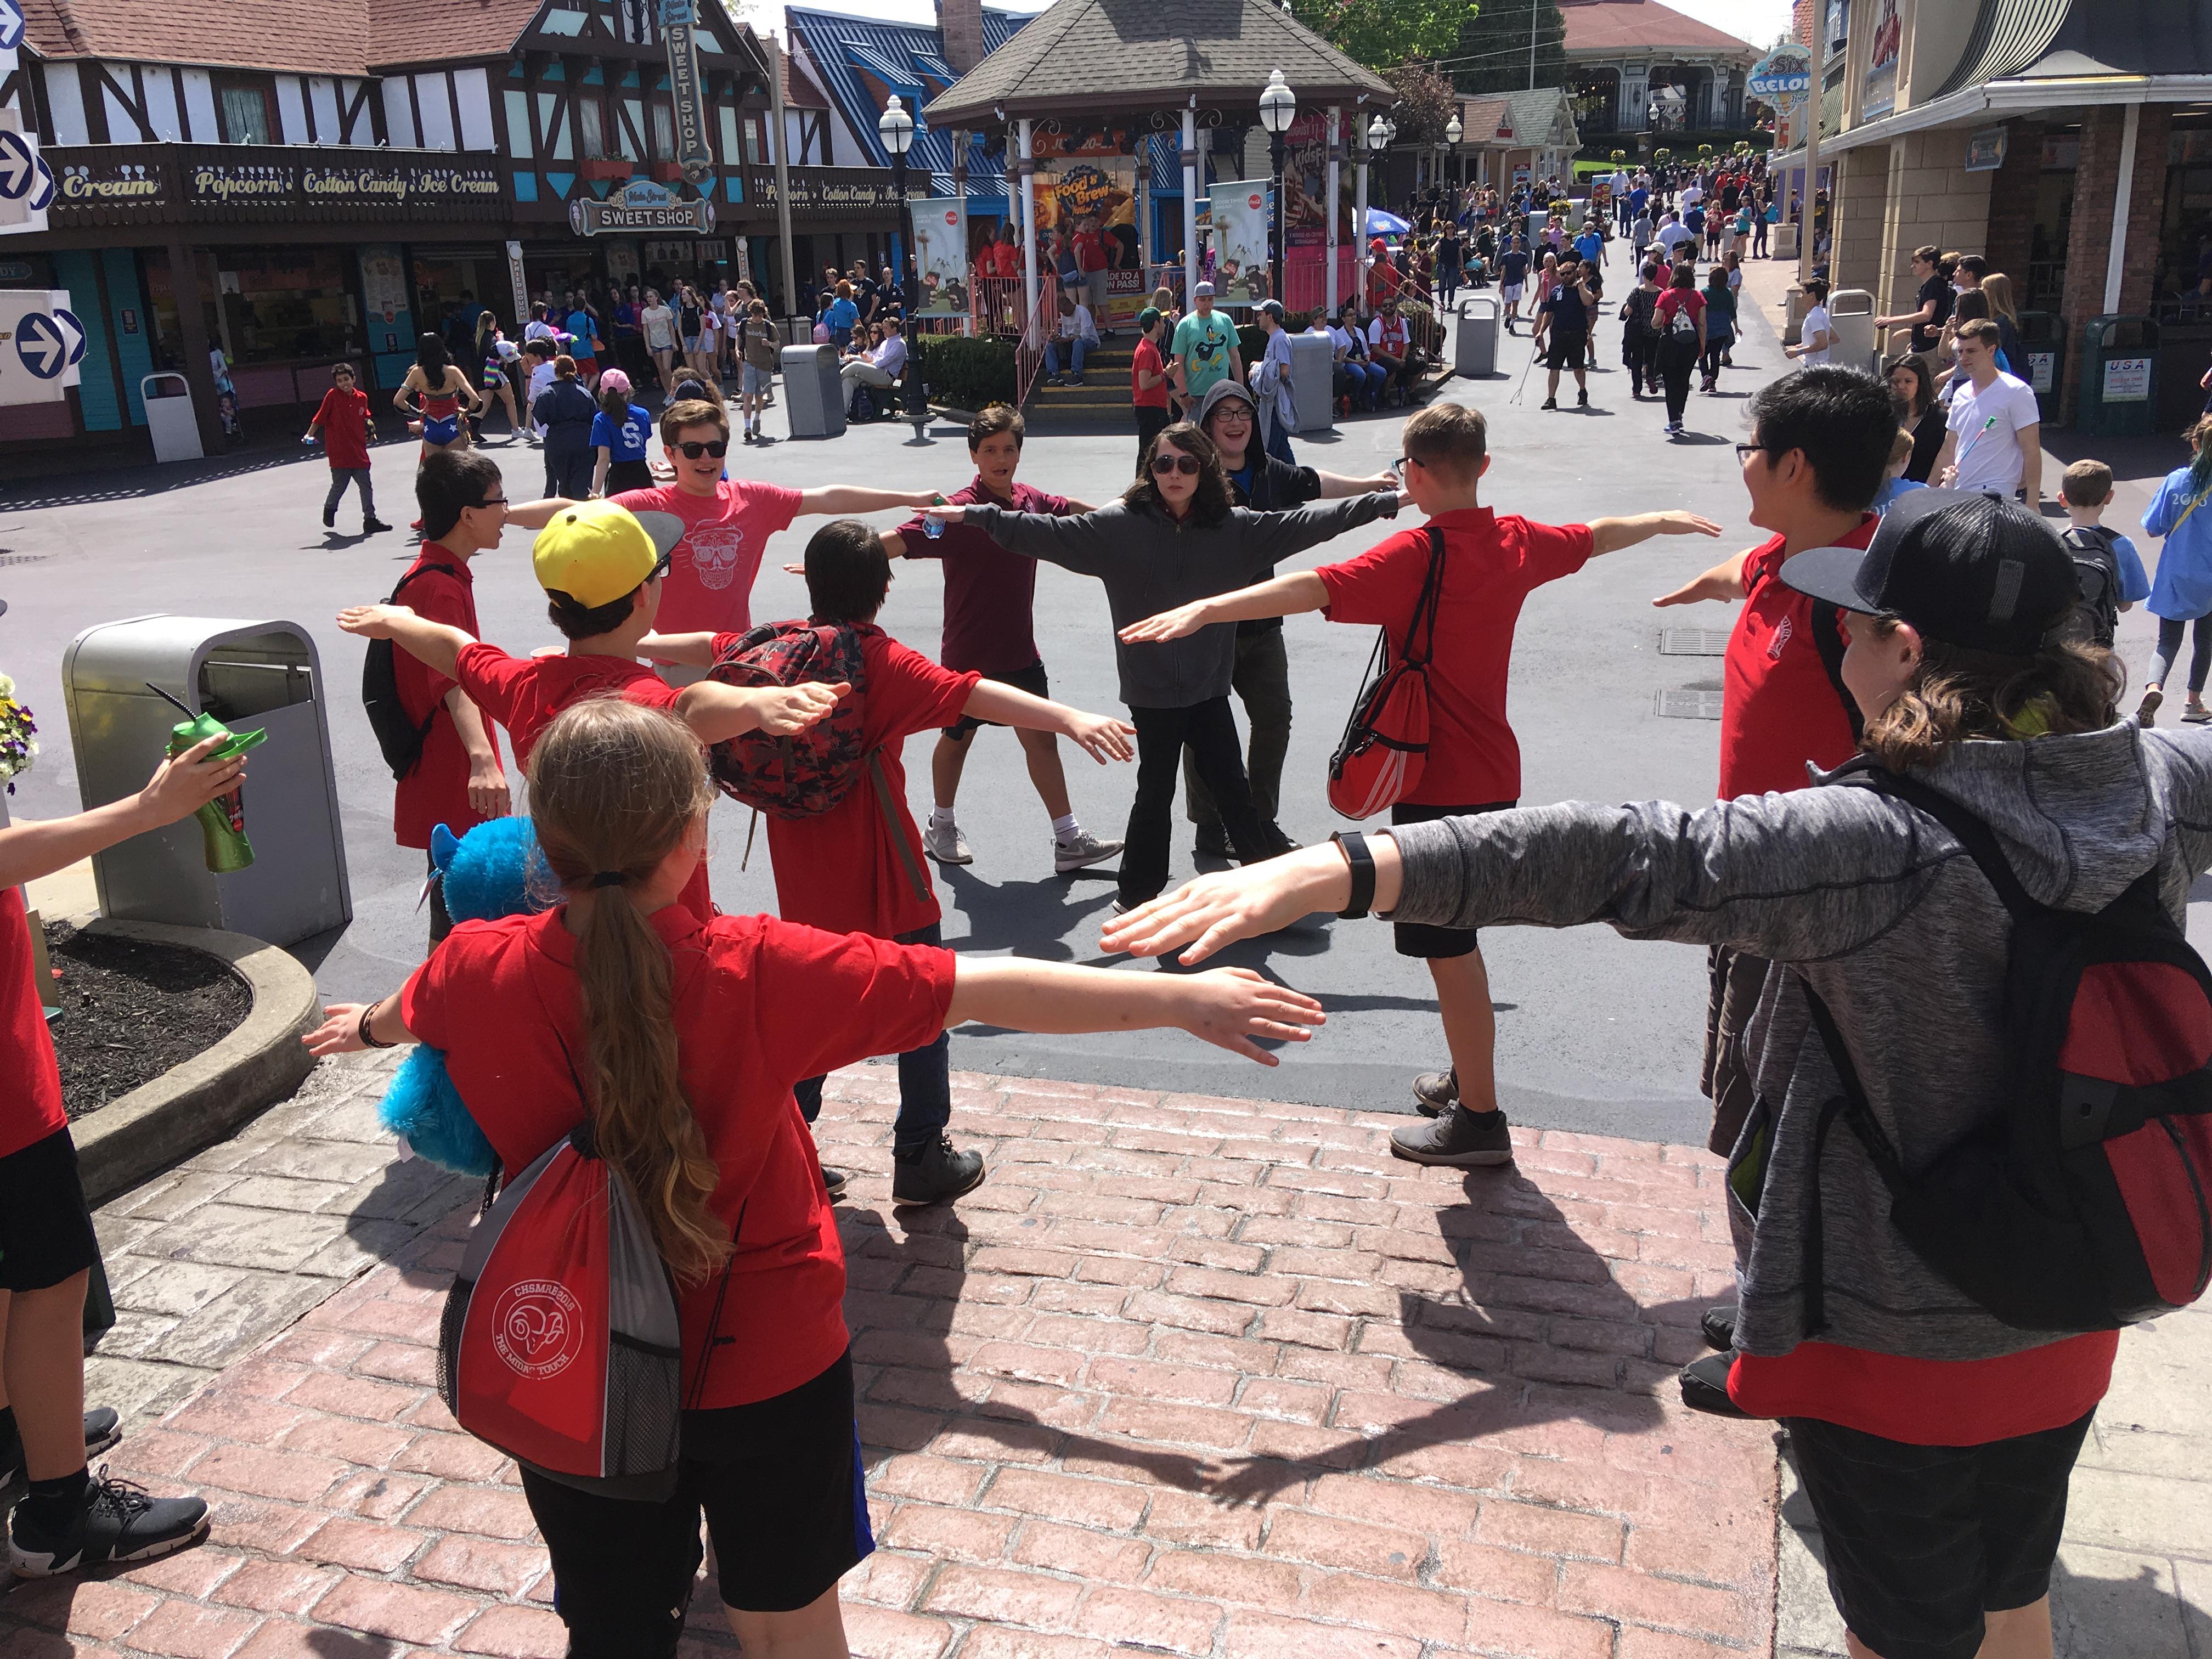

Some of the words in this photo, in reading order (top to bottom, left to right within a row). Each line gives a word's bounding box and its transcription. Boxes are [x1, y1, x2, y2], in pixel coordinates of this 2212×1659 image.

[671, 27, 690, 95] SWEET
[1772, 54, 1808, 75] Six
[680, 100, 697, 153] SHOP
[63, 175, 158, 198] Cream
[195, 172, 281, 200] Popcorn
[303, 172, 357, 194] Cotton
[358, 172, 407, 200] Candy
[419, 174, 447, 193] Ice
[451, 174, 499, 193] Cream
[822, 186, 849, 201] Cotton
[850, 186, 876, 205] Candy
[885, 186, 899, 201] Ice
[1054, 174, 1088, 200] Food
[1075, 185, 1109, 205] Brew
[601, 210, 653, 225] SWEET
[657, 210, 693, 225] SHOP
[514, 261, 522, 287] FRIED
[1121, 272, 1132, 280] TO
[517, 290, 526, 317] DOUGH
[496, 1334, 509, 1355] THE
[537, 1353, 569, 1375] TOUCH
